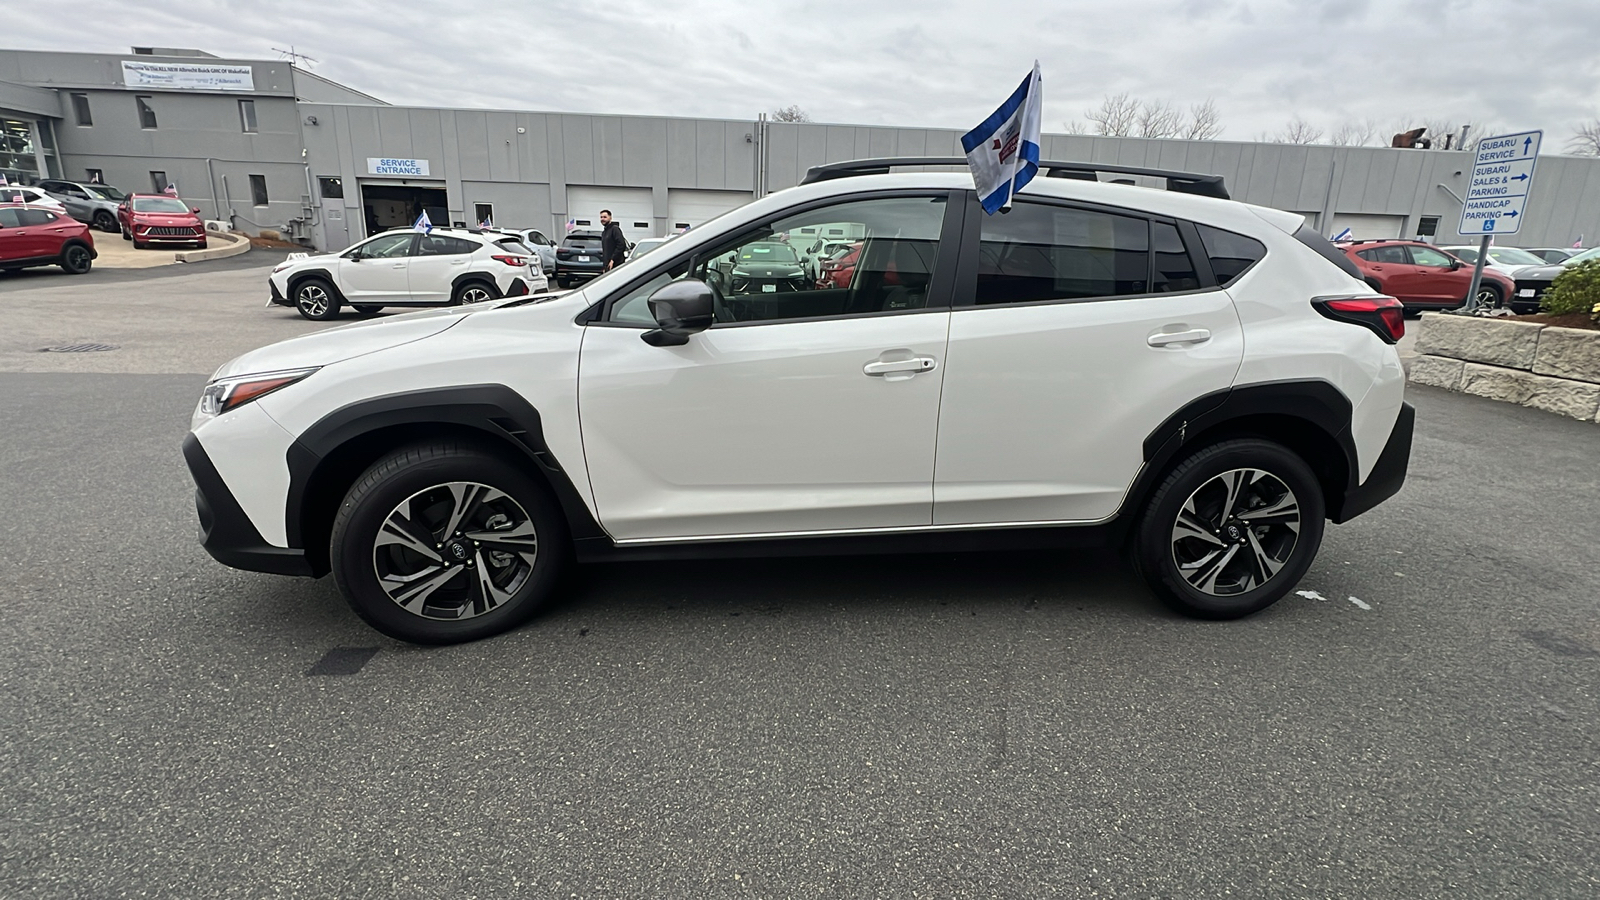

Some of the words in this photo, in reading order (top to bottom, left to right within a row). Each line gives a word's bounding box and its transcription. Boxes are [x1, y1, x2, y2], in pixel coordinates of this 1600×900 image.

[1482, 139, 1517, 150] SUBARU
[1479, 150, 1515, 161] SERVICE
[380, 159, 416, 167] SERVICE
[1476, 166, 1510, 176] SUBARU
[1473, 177, 1500, 186] SALES
[1470, 187, 1508, 196] PARKING
[1467, 200, 1510, 210] HANDICAP
[1465, 211, 1501, 220] PARKING
